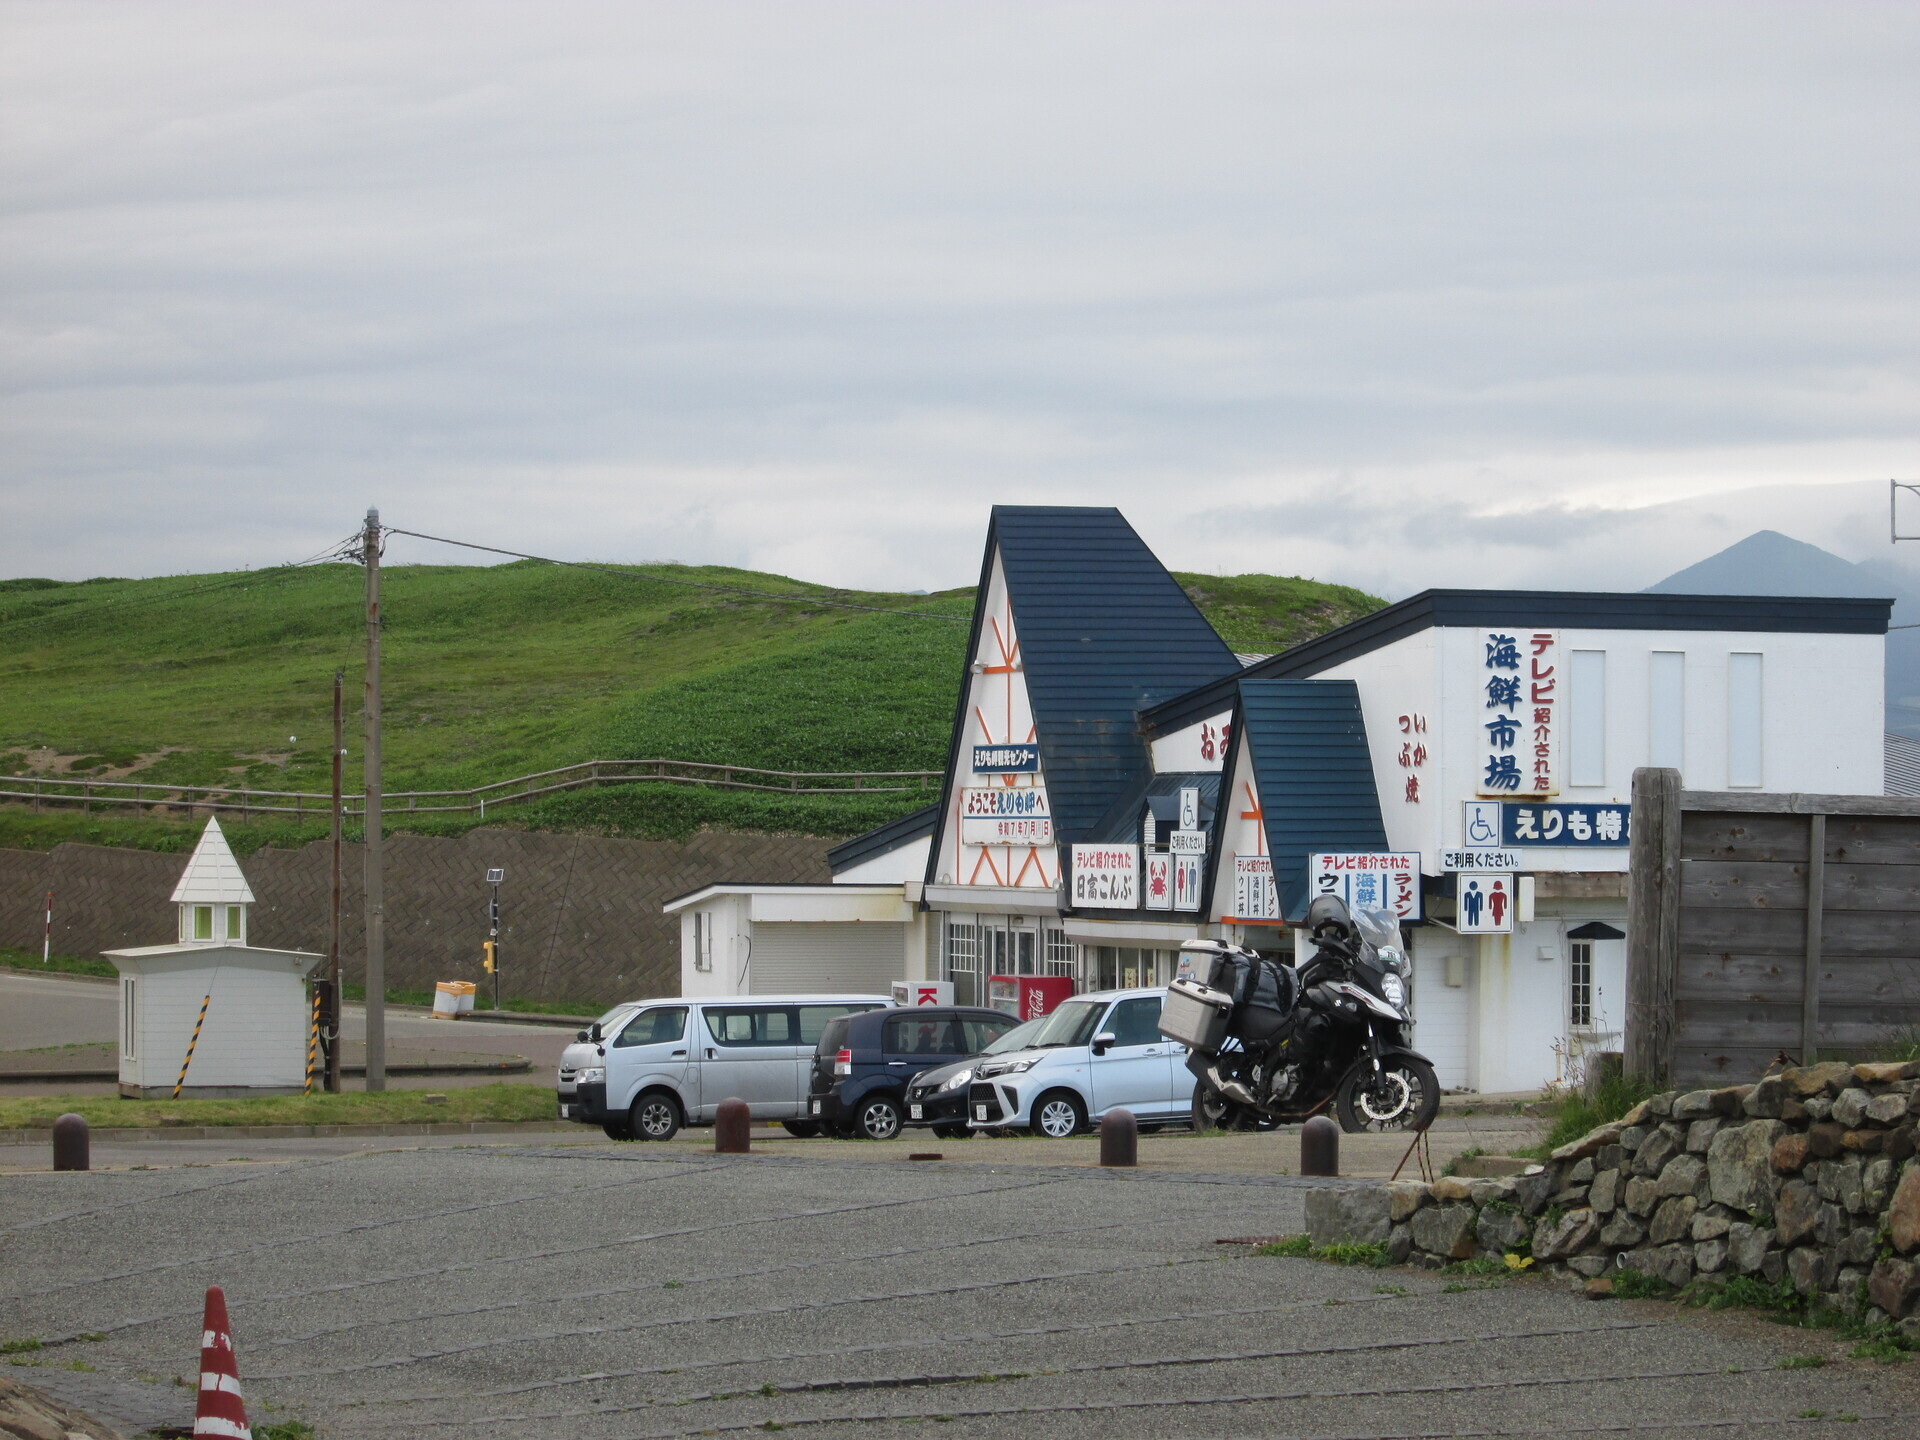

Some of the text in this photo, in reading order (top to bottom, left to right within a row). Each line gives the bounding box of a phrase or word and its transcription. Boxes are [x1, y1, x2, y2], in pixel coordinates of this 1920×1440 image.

[1484, 634, 1523, 791] 海鮮市場
[1530, 634, 1556, 790] テレビ紹介された
[968, 791, 1044, 814] ようこそえりも岬へ
[998, 821, 1049, 836] 令和7年7月日
[1515, 808, 1631, 841] えりも特
[1077, 851, 1132, 869] テレビ紹介された
[1238, 859, 1272, 872] テレビ紹介され
[1322, 856, 1410, 870] テレビ紹介された
[1445, 852, 1519, 868] ご利用ください。
[1077, 873, 1132, 900] 日高こんぶ
[1355, 873, 1377, 906] 海鮮
[1393, 873, 1413, 918] ラーメン
